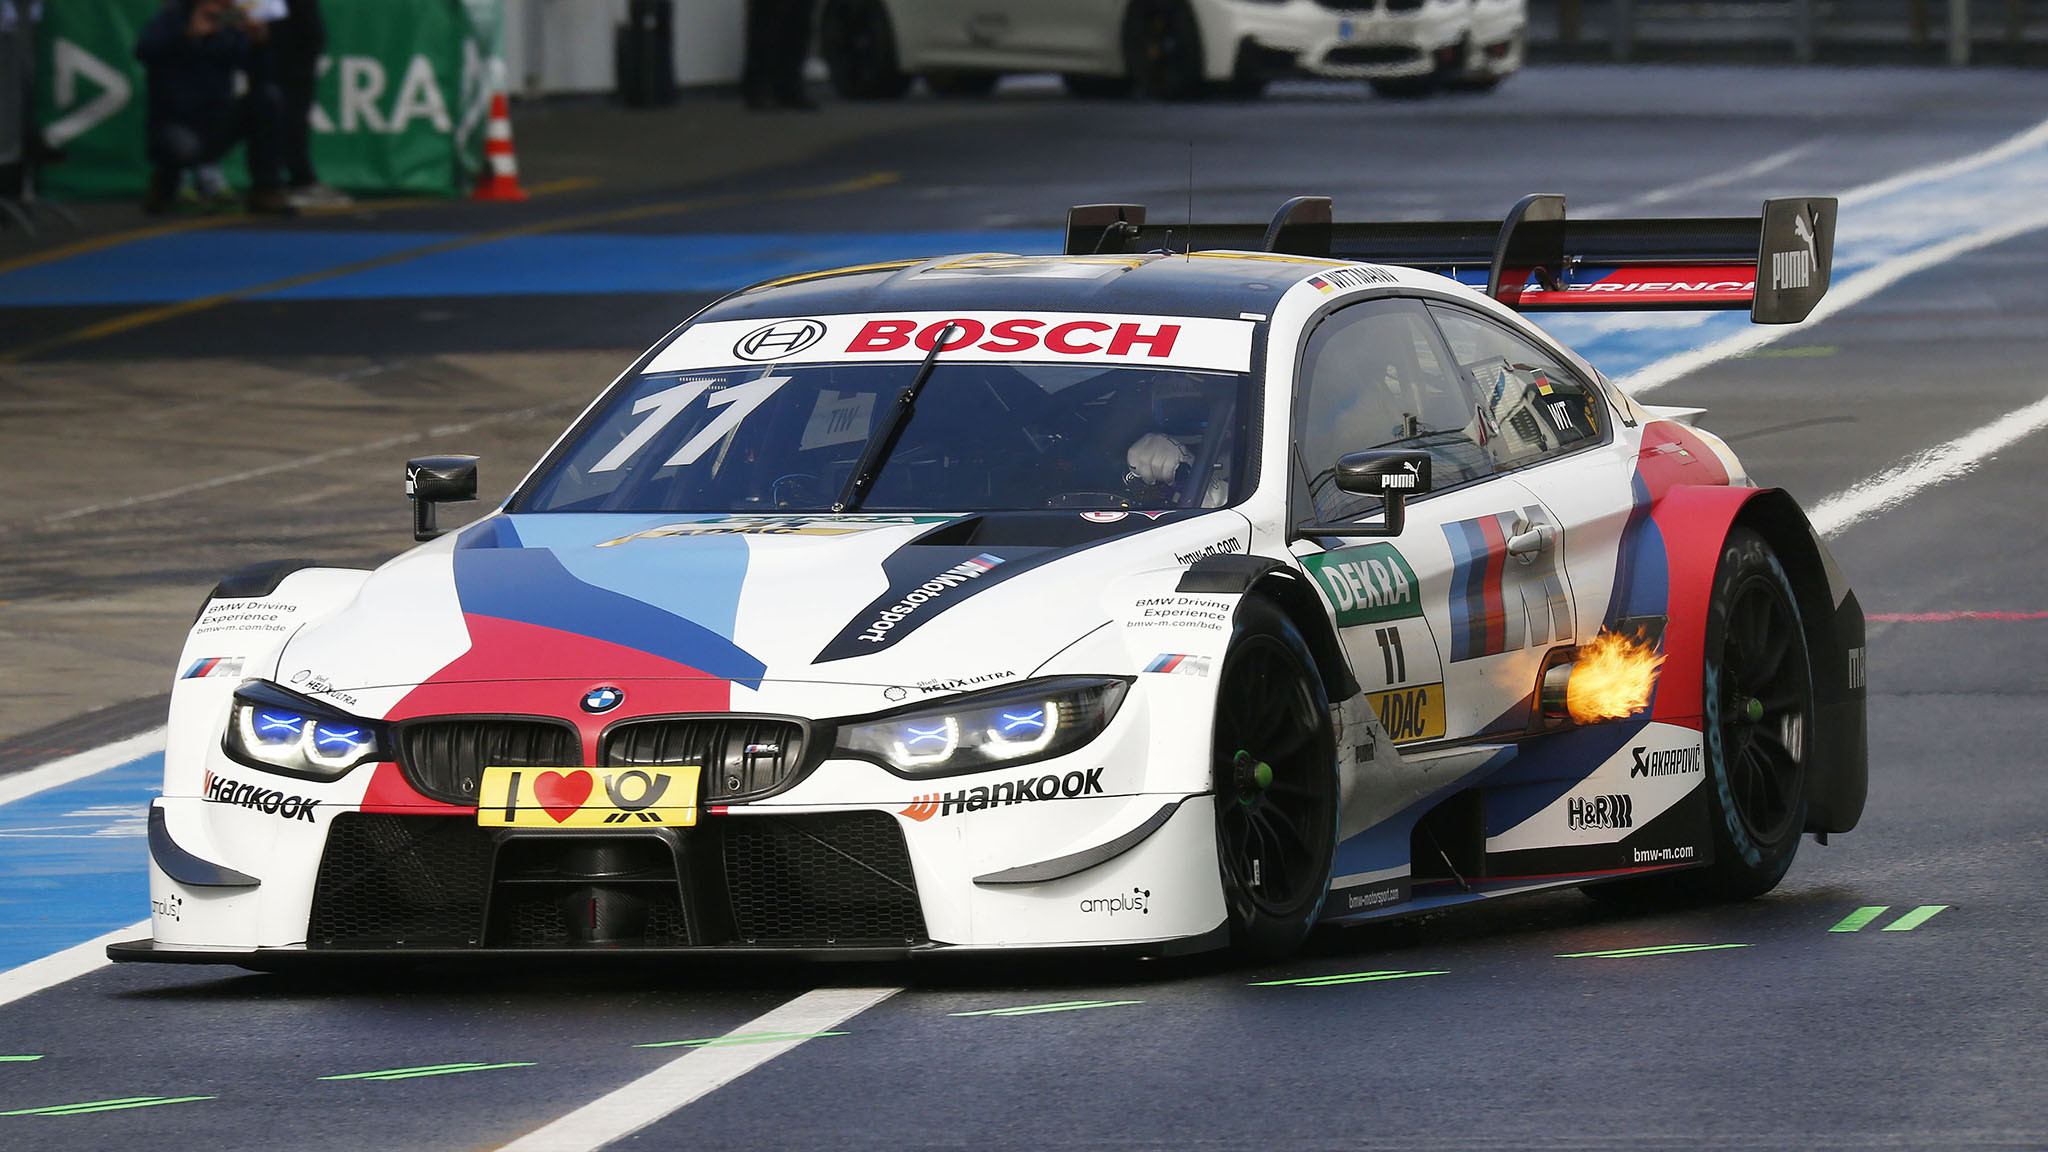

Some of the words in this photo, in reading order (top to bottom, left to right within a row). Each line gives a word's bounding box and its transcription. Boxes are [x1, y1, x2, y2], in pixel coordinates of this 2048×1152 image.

[1320, 266, 1399, 289] WITTMANN
[1772, 250, 1809, 290] PUMA
[845, 318, 1181, 357] BOSCH
[588, 376, 793, 473] 11
[1547, 401, 1573, 430] WIT
[1381, 474, 1415, 488] PUMA
[1321, 556, 1411, 612] DEKRA
[207, 602, 246, 614] BMW
[246, 601, 297, 613] Driving
[858, 569, 968, 643] Motorsport
[1135, 598, 1175, 607] BMW
[1177, 597, 1230, 611] Driving
[1144, 608, 1226, 621] Experience
[196, 624, 287, 635] bmw-m.com/bde
[201, 612, 278, 625] Experience
[1126, 620, 1223, 631] bmw-m.com/bde
[1375, 626, 1406, 685] 11
[969, 670, 1016, 684] ULTRA
[1381, 688, 1427, 740] ADAC
[1568, 796, 1609, 830] H&R
[1633, 846, 1694, 862] bmw-m.com
[1080, 893, 1143, 916] amplus
